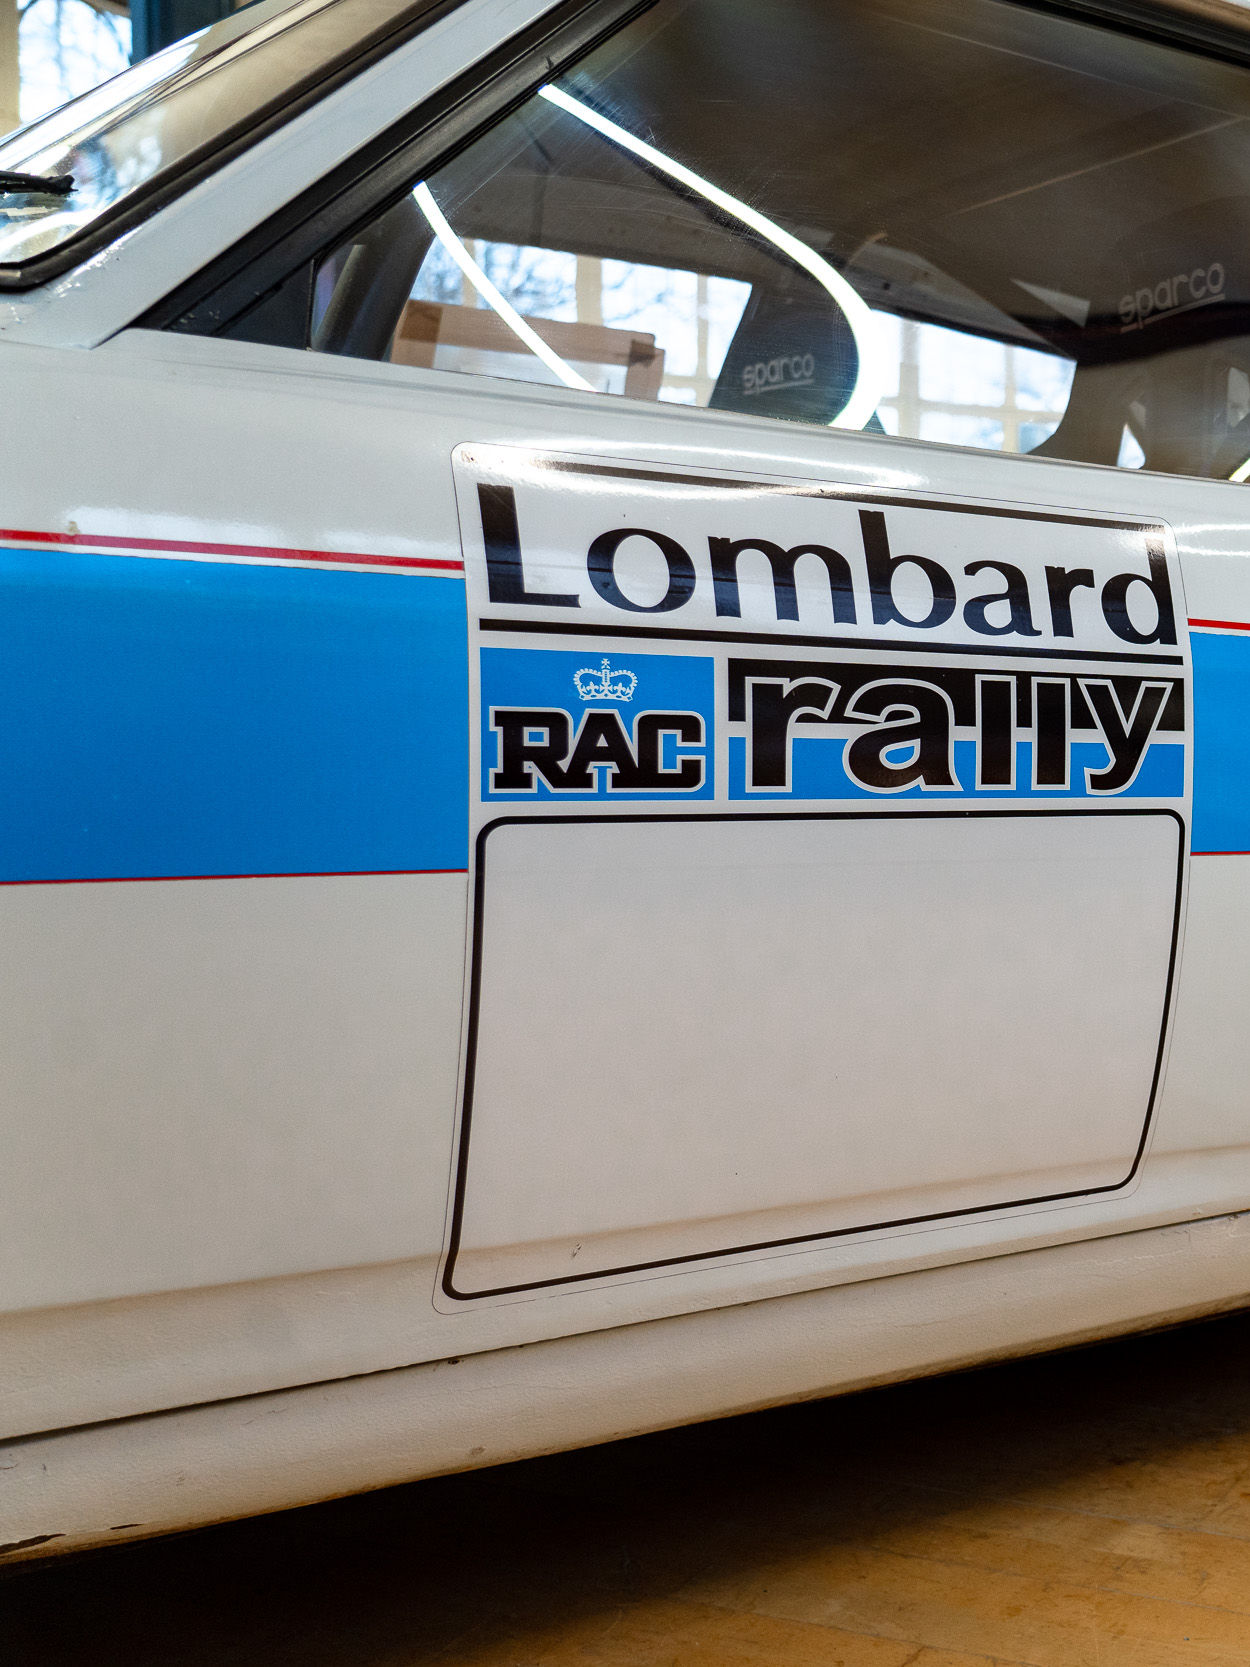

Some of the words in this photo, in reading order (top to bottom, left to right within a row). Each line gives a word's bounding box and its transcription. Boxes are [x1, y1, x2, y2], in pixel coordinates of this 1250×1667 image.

[1119, 262, 1225, 330] sparco
[743, 354, 814, 394] sparco
[477, 483, 1179, 645] Lombard
[489, 707, 706, 793] RAC
[745, 674, 1173, 795] rally
